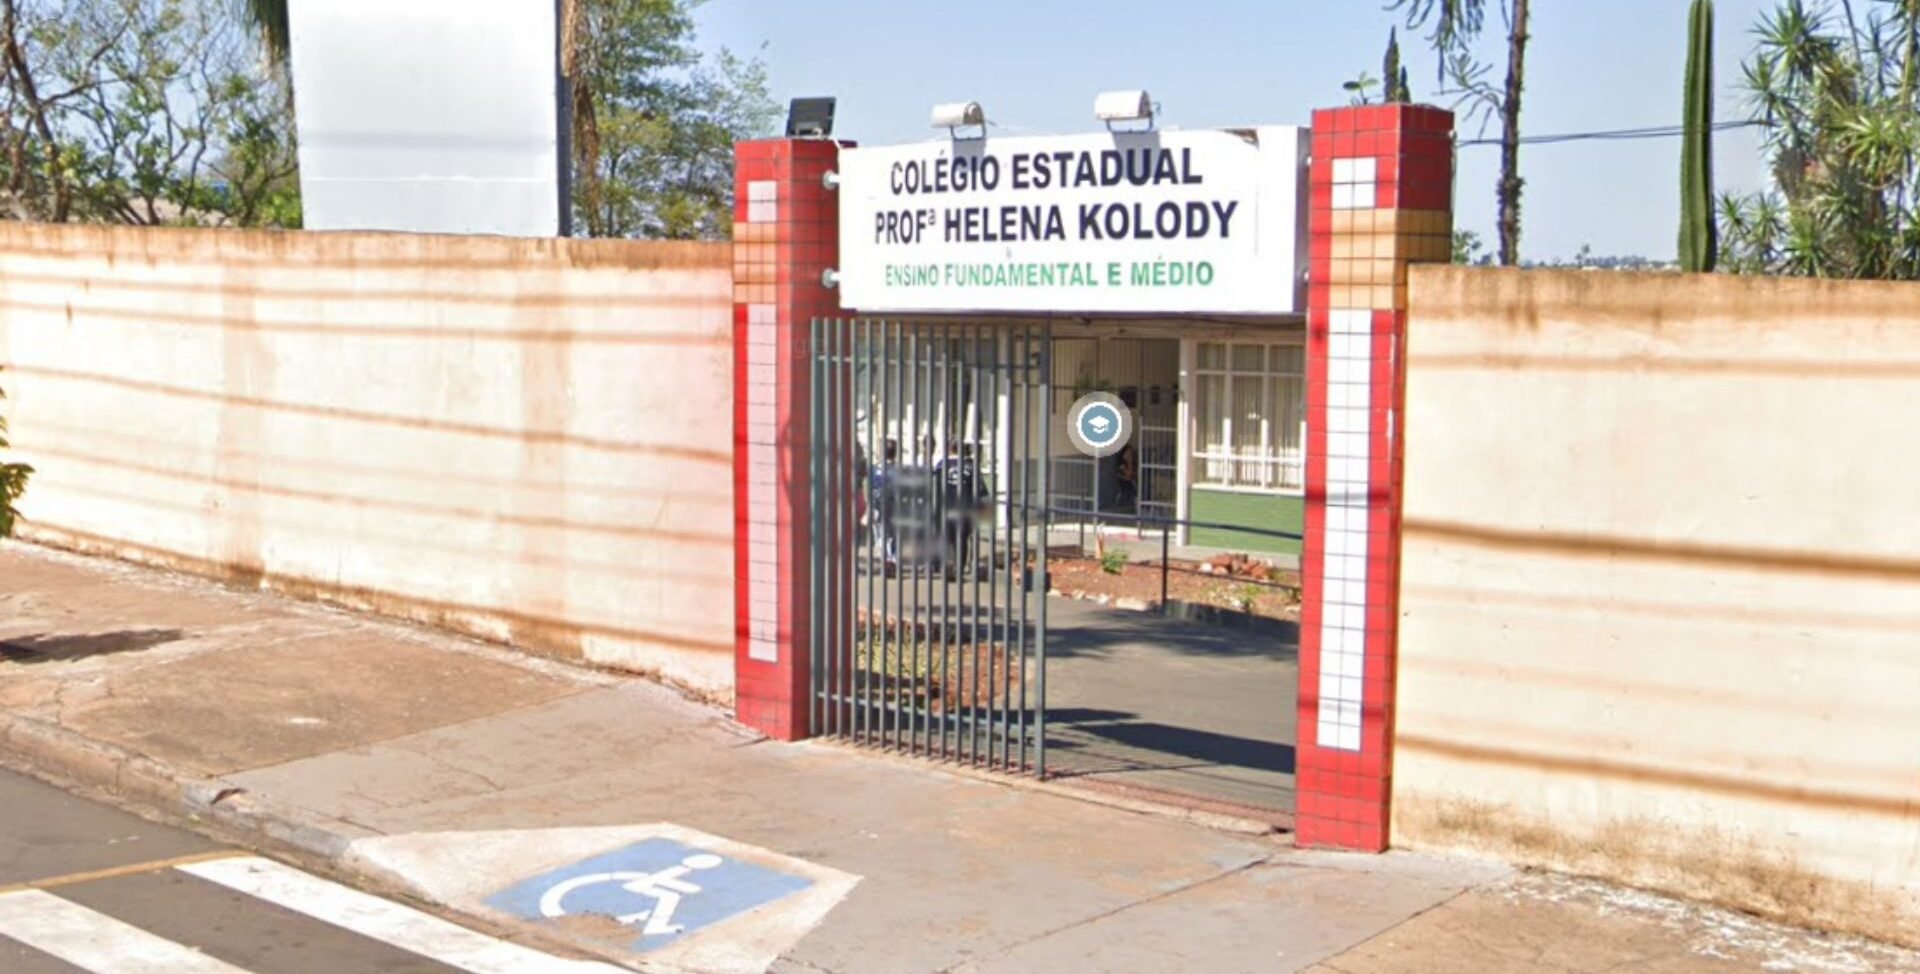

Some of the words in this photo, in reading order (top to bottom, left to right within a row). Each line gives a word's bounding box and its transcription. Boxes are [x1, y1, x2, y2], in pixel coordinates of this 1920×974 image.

[890, 150, 1001, 196] COLÉGIO
[1011, 147, 1203, 190] ESTADUAL
[944, 205, 1066, 243] HELENA
[1079, 200, 1239, 241] KOLODY
[885, 263, 939, 287] ENSINO
[944, 261, 1098, 288] FUNDAMENTAL
[1107, 261, 1122, 287] E
[1130, 256, 1215, 287] MÉDIO
